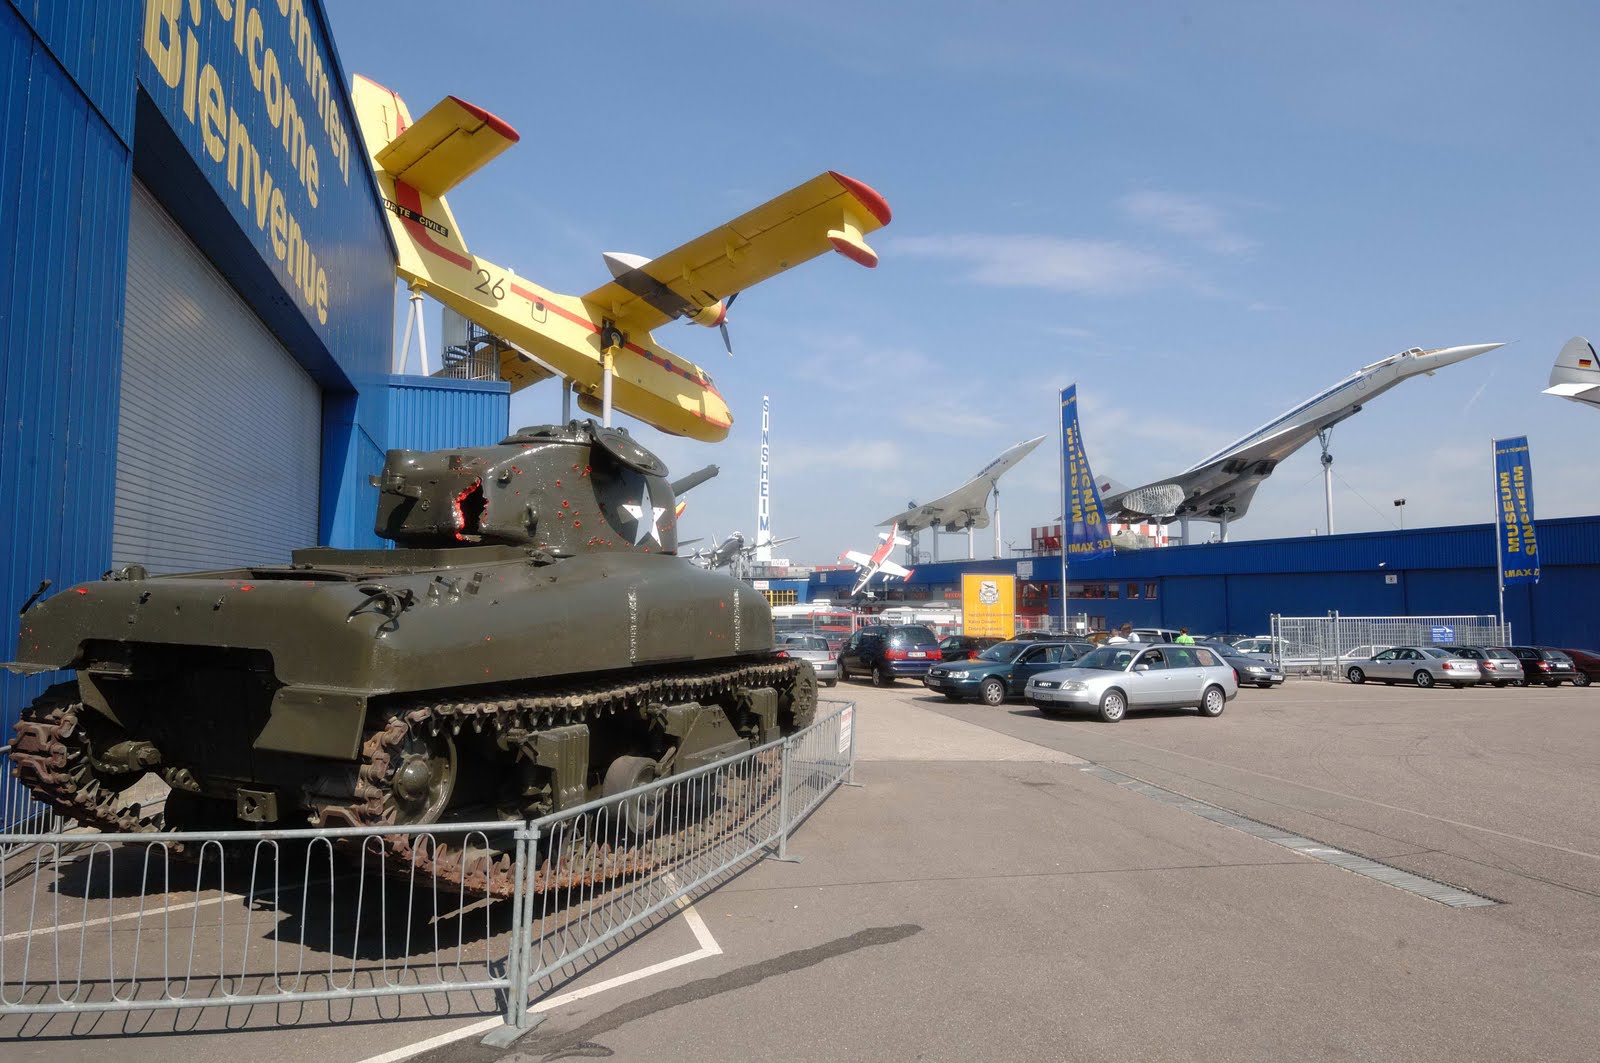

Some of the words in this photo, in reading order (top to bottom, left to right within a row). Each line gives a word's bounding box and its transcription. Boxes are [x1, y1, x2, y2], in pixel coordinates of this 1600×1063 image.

[144, 0, 328, 325] Bienvenue
[383, 199, 411, 219] URITE
[419, 216, 447, 237] CIVILE
[474, 268, 505, 300] 26
[760, 399, 770, 531] SINSHEIM
[1500, 471, 1520, 553] MUSEUM
[1068, 541, 1096, 553] IMAX
[1097, 539, 1112, 550] 3D
